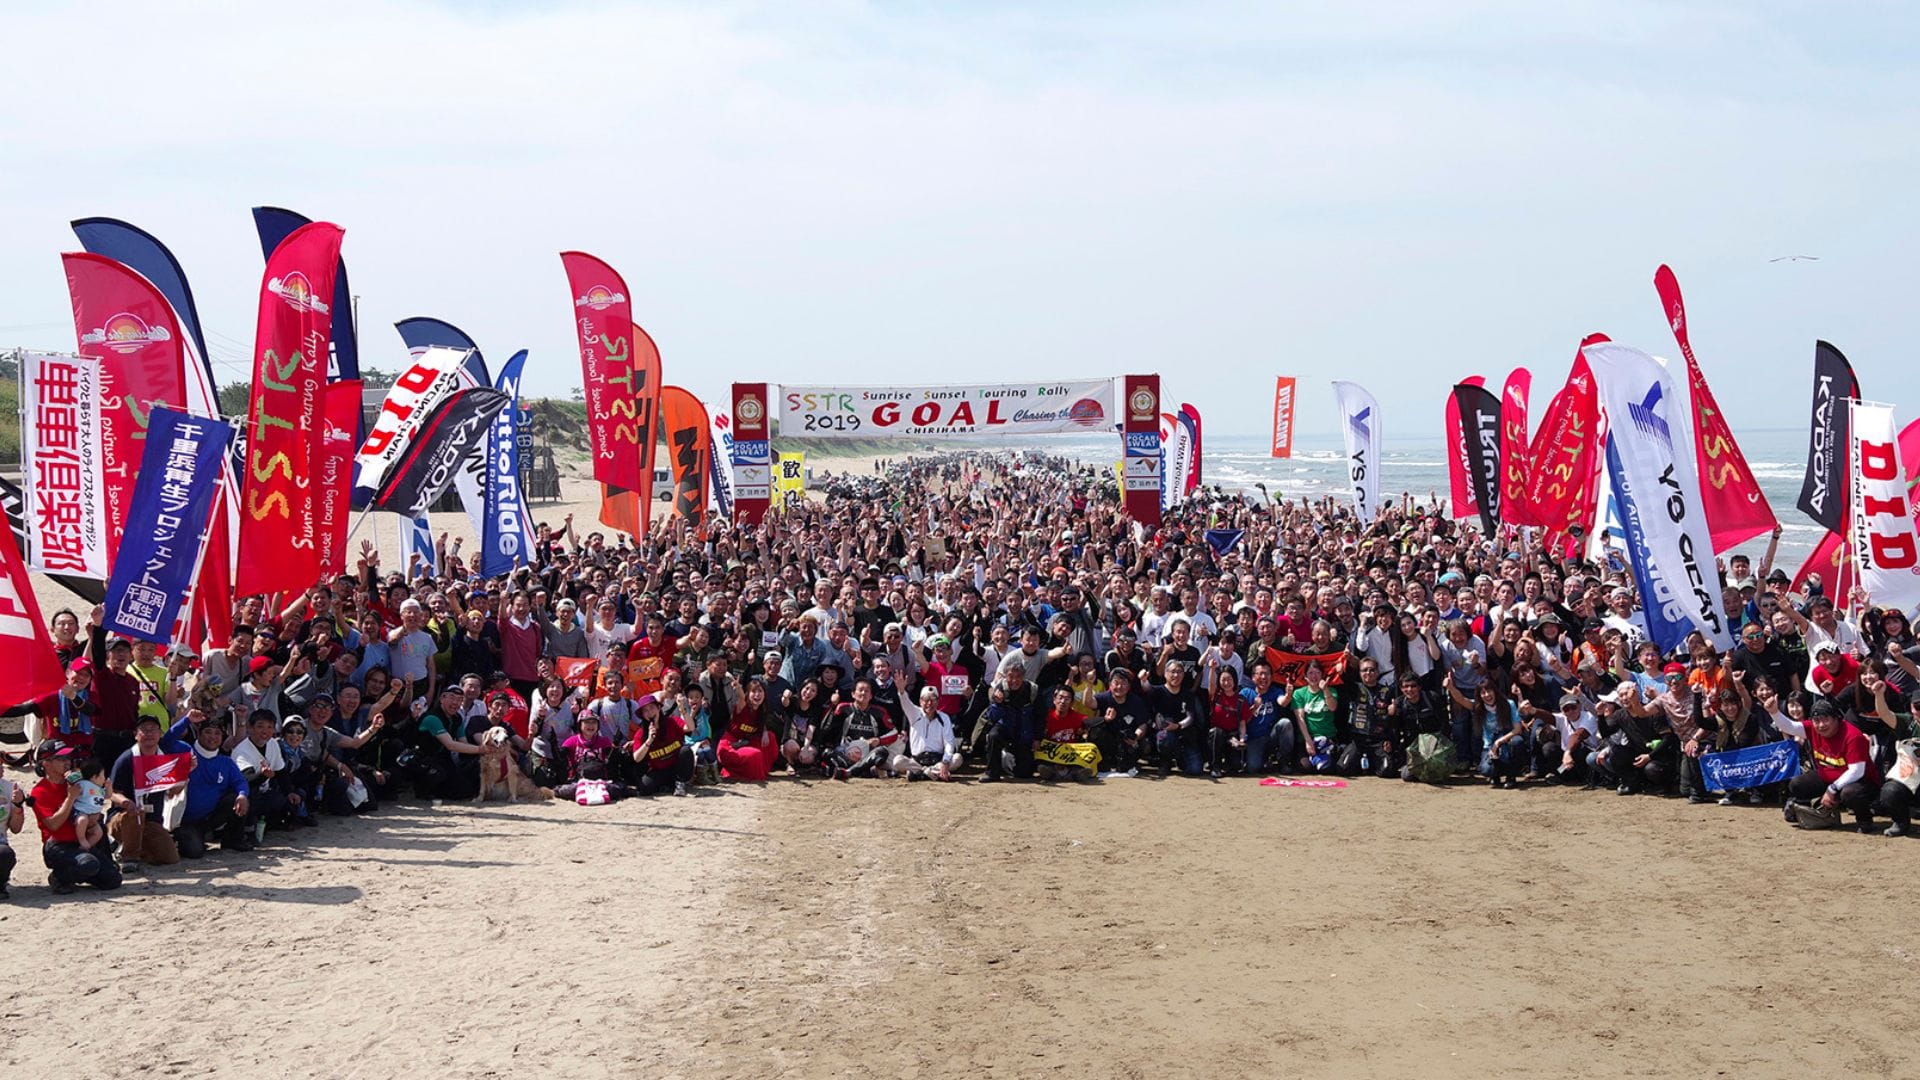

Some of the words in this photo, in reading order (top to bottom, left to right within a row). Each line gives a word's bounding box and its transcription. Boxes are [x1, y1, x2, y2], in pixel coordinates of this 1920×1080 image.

[786, 392, 856, 413] SSTR
[862, 391, 912, 401] Sunrise
[923, 390, 967, 400] Sunset
[978, 388, 1028, 400] Touring
[1037, 386, 1071, 397] Rally
[804, 414, 861, 431] 2019
[871, 400, 1008, 427] GOAL
[1012, 409, 1056, 422] Chasing
[249, 348, 301, 521] SSTR
[34, 359, 88, 574] 単車倶楽部
[409, 406, 486, 512] KADOYA
[140, 422, 204, 586] 千里浜再生プロジェクト
[1857, 513, 1872, 571] CHAIN
[127, 586, 165, 610] 千里浜
[127, 601, 155, 618] 再生
[117, 612, 155, 634] Project
